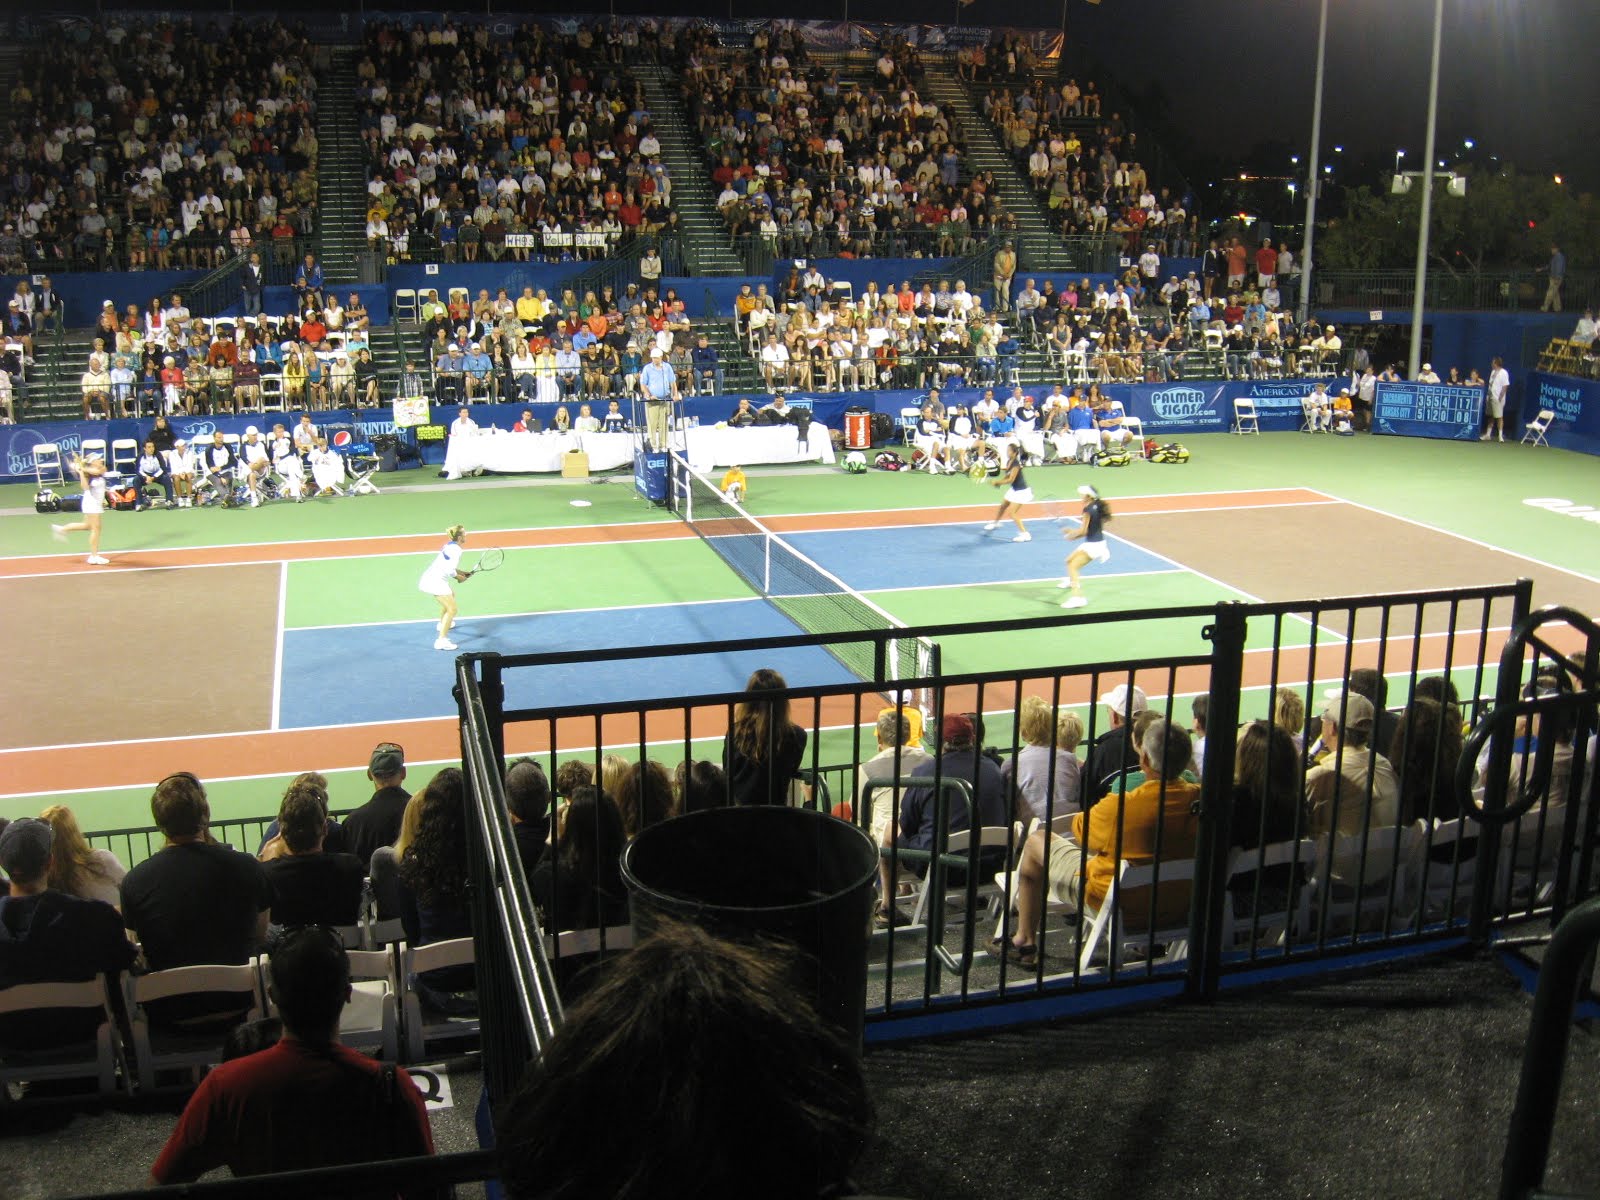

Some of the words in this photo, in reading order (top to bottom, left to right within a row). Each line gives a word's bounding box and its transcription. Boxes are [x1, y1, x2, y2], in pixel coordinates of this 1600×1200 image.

[1249, 385, 1300, 396] AMERICAN
[1541, 382, 1568, 398] Home
[1569, 388, 1580, 400] of
[1153, 392, 1204, 404] PALMER
[1418, 395, 1424, 406] 3
[1426, 396, 1432, 407] 5
[1434, 396, 1440, 407] 5
[1442, 397, 1448, 407] 4
[1539, 395, 1553, 407] the
[1556, 398, 1581, 414] Caps!
[1417, 409, 1423, 419] 5
[1433, 410, 1439, 421] 2
[1441, 410, 1446, 421] 0
[408, 1070, 445, 1103] Q
